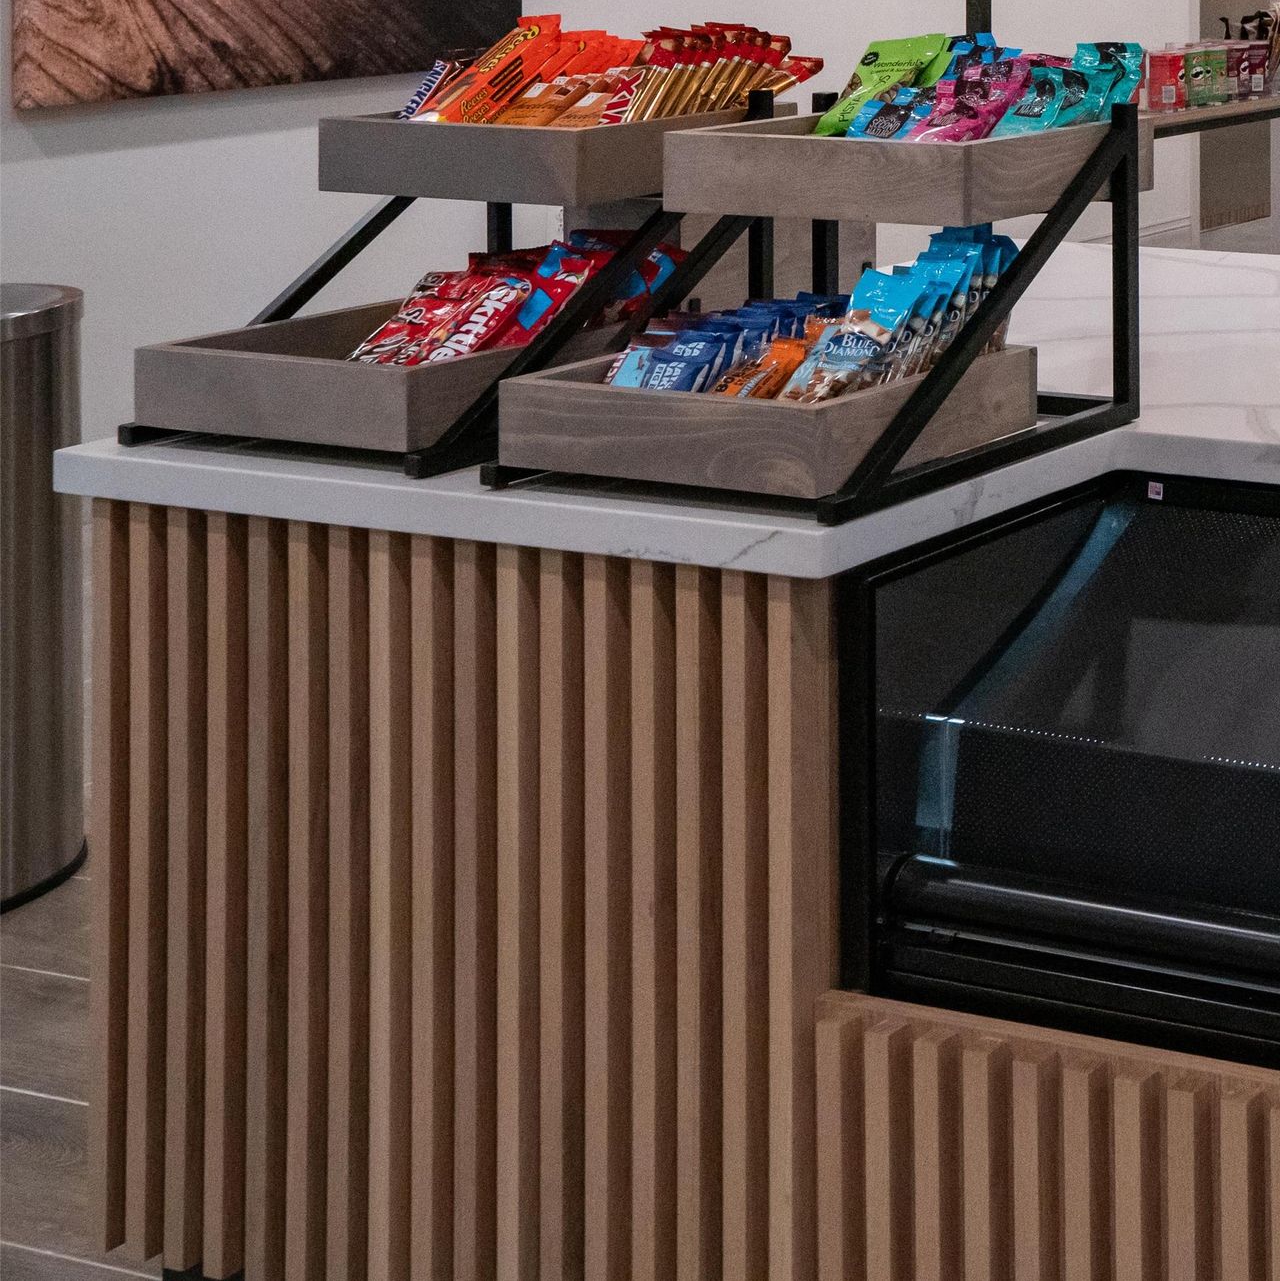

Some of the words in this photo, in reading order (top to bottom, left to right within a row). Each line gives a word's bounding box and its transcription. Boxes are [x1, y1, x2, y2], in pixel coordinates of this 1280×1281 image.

[872, 58, 920, 70] Wonderful
[397, 59, 447, 120] SNICKERS
[425, 285, 519, 362] Skittle
[824, 341, 881, 358] DIAMOND
[842, 333, 873, 351] BLUE
